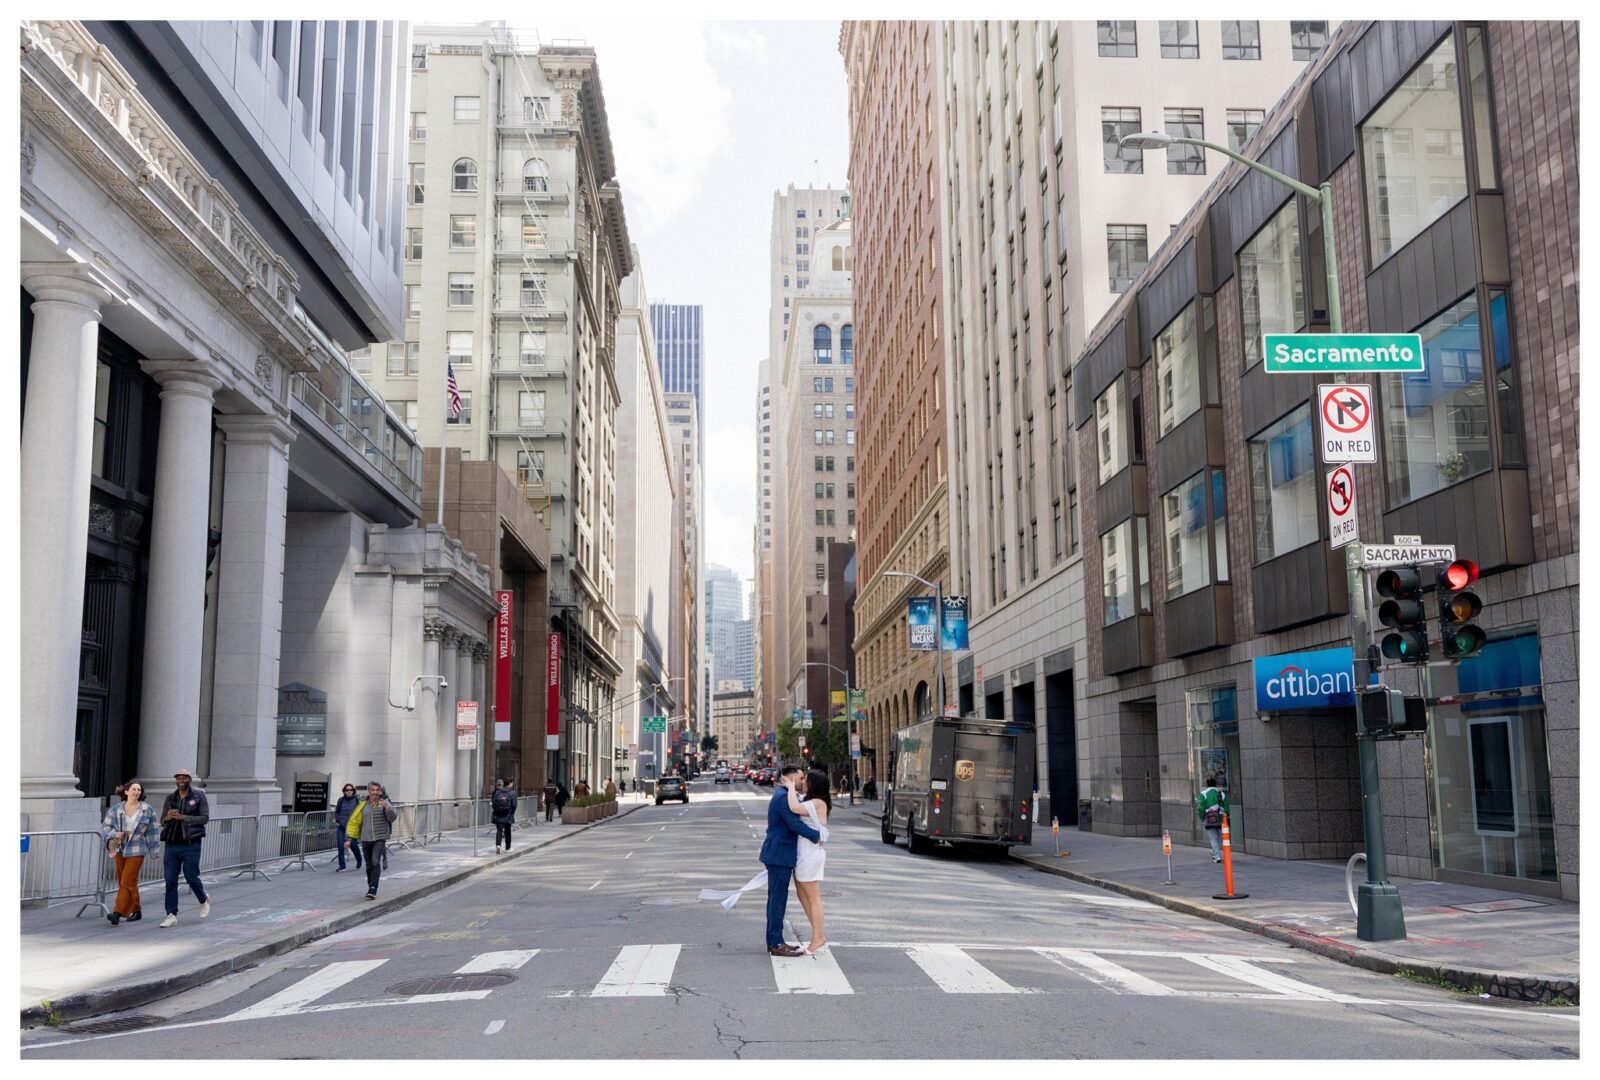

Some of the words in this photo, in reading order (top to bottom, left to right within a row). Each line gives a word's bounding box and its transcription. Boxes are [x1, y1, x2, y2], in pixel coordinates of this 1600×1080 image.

[1274, 343, 1414, 364] Sacramento
[1327, 440, 1342, 453] ON
[1348, 440, 1371, 452] RED
[1333, 526, 1341, 538] ON
[1342, 519, 1355, 533] RED
[500, 593, 509, 625] FARGO
[911, 624, 934, 634] UNSEEN
[500, 626, 509, 659] WELLS
[911, 634, 935, 644] OCEANS
[957, 768, 973, 779] ups
